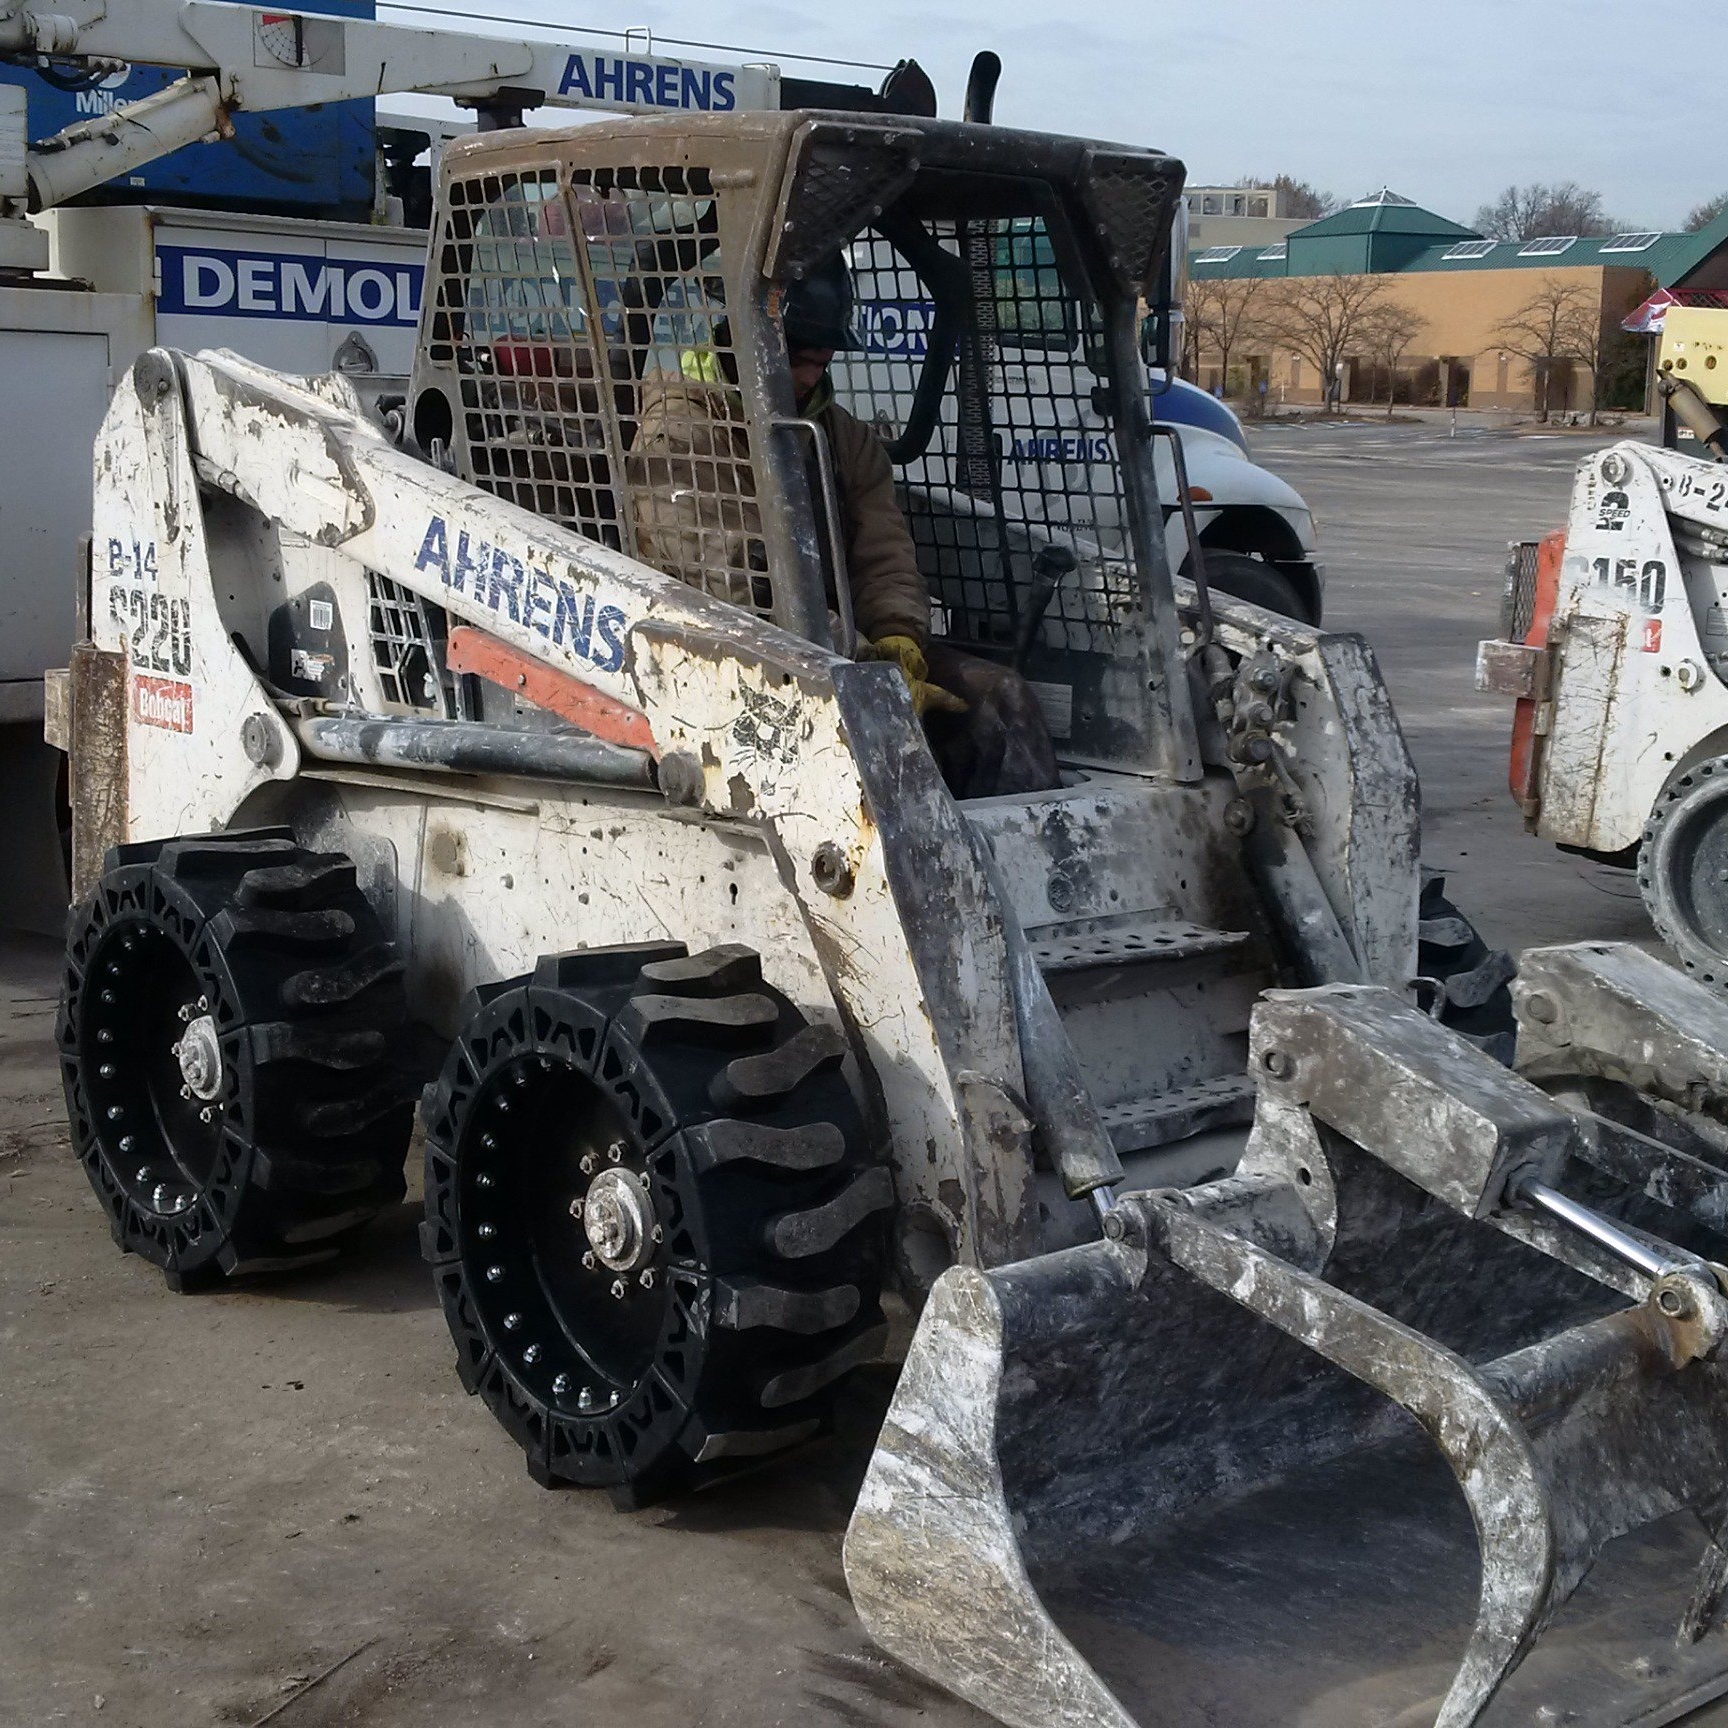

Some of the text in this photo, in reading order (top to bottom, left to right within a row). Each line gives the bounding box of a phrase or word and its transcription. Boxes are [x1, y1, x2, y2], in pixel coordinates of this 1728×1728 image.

[557, 53, 736, 112] AHRENS
[76, 89, 138, 115] Mille
[1007, 437, 1108, 466] AHRENS
[1598, 508, 1631, 519] SPEED
[413, 514, 627, 674] AHRENS
